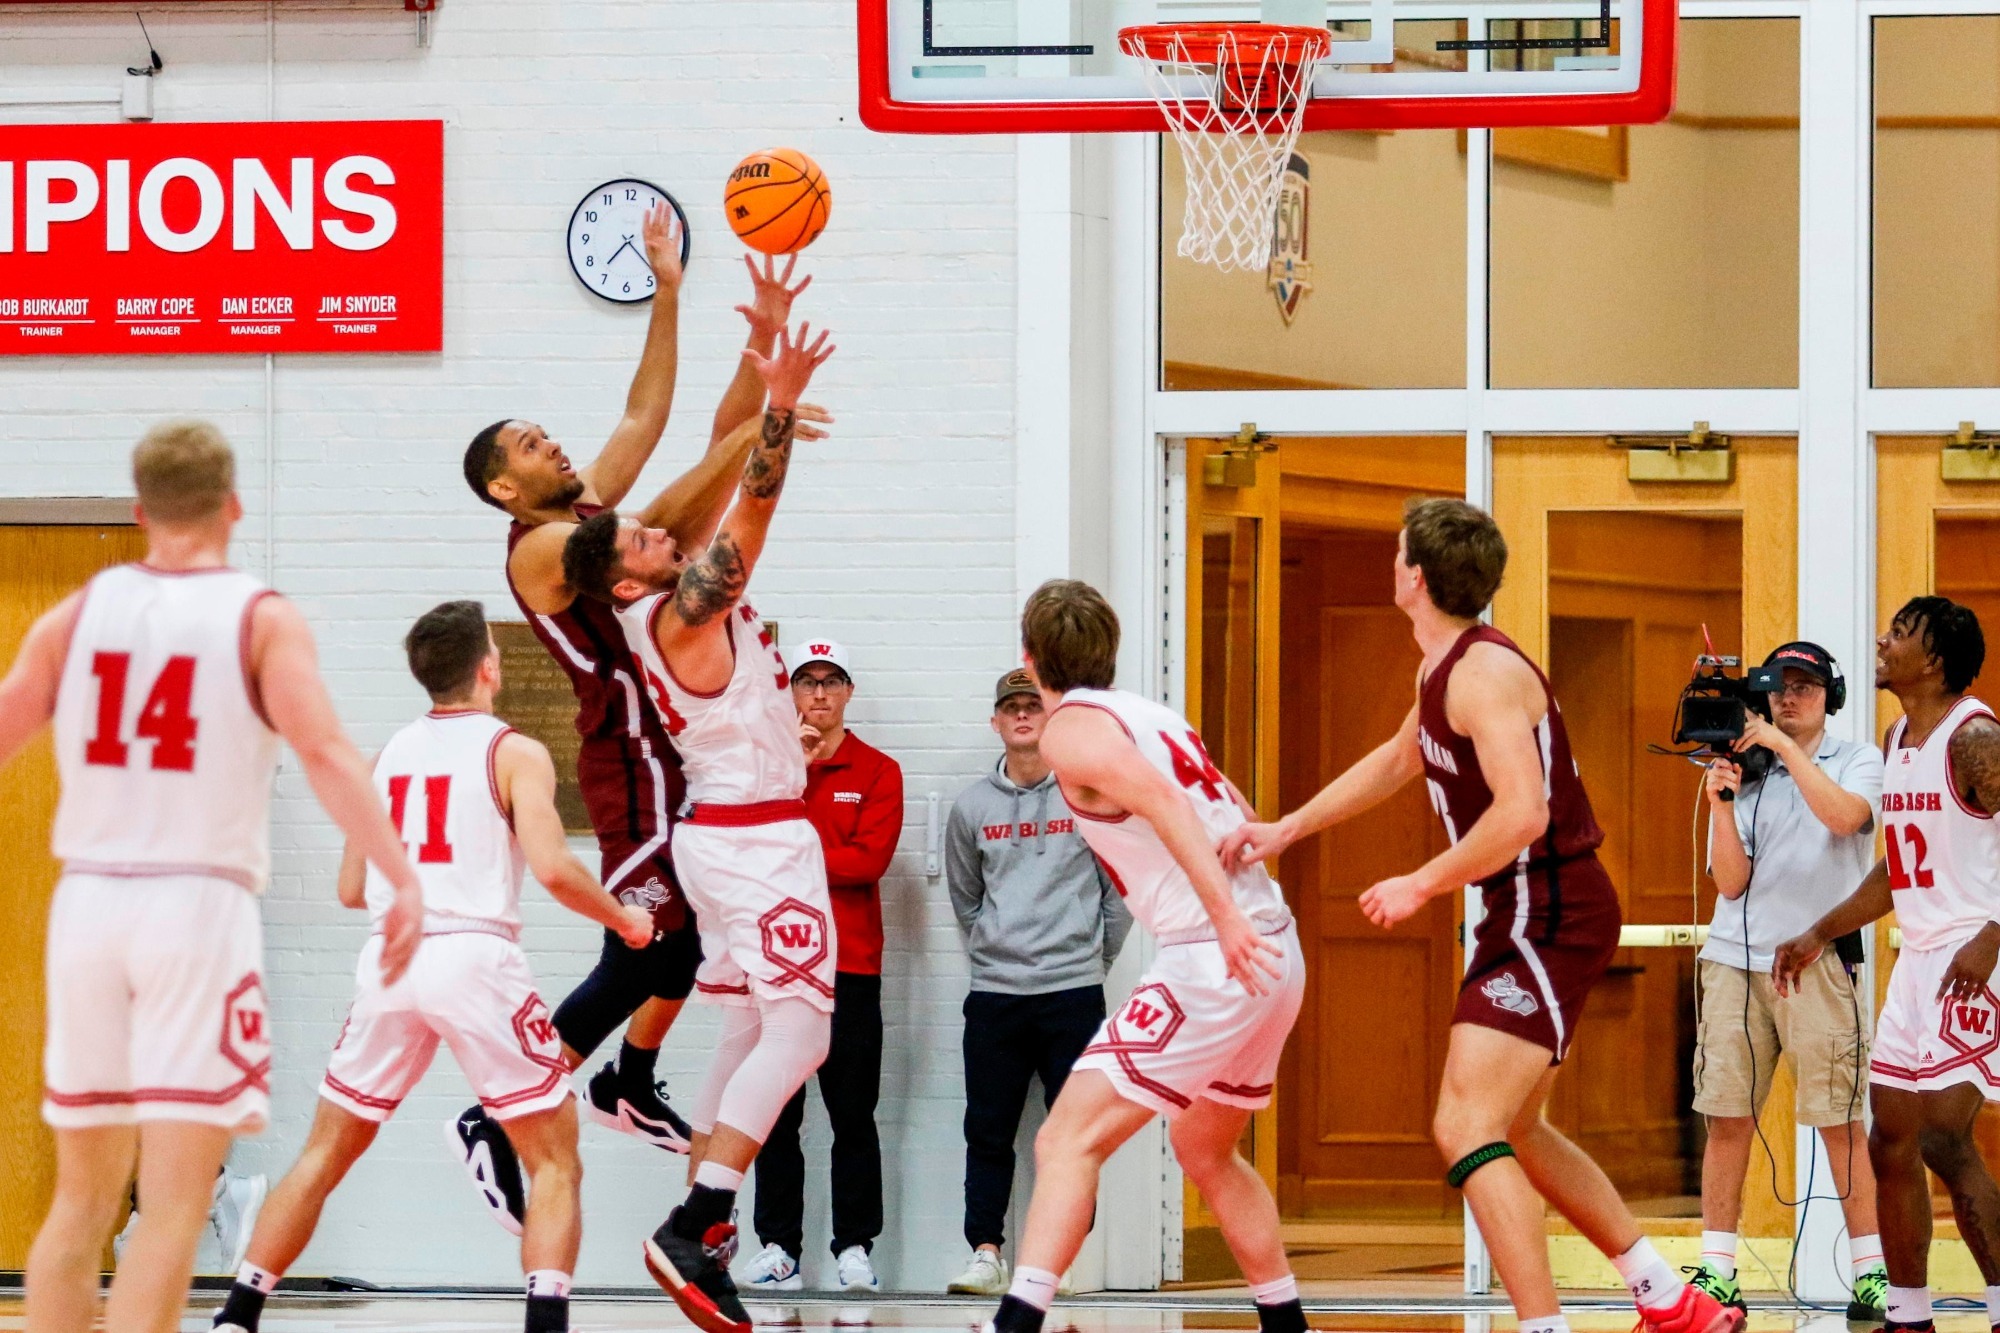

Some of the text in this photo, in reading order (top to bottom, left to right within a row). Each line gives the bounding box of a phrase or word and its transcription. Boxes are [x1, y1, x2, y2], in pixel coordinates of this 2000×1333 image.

[603, 194, 612, 206] 11
[625, 189, 637, 201] 12
[650, 197, 655, 208] 1
[585, 211, 598, 223] 10
[581, 233, 590, 245] 9
[586, 255, 594, 267] 8
[601, 273, 608, 285] 7
[646, 275, 654, 287] 5
[622, 281, 631, 293] 6
[23, 298, 90, 316] BURKARDT
[117, 297, 195, 315] BARRY COPE
[222, 297, 293, 315] DAN ECKER
[318, 295, 397, 313] JIM SNYDER
[20, 326, 63, 337] TRAINER
[130, 325, 181, 336] MANAGER
[231, 325, 282, 335] MANAGER
[333, 324, 377, 334] TRAINER
[85, 651, 199, 773] 14
[1884, 822, 1935, 891] 12
[1632, 1279, 1652, 1298] 23
